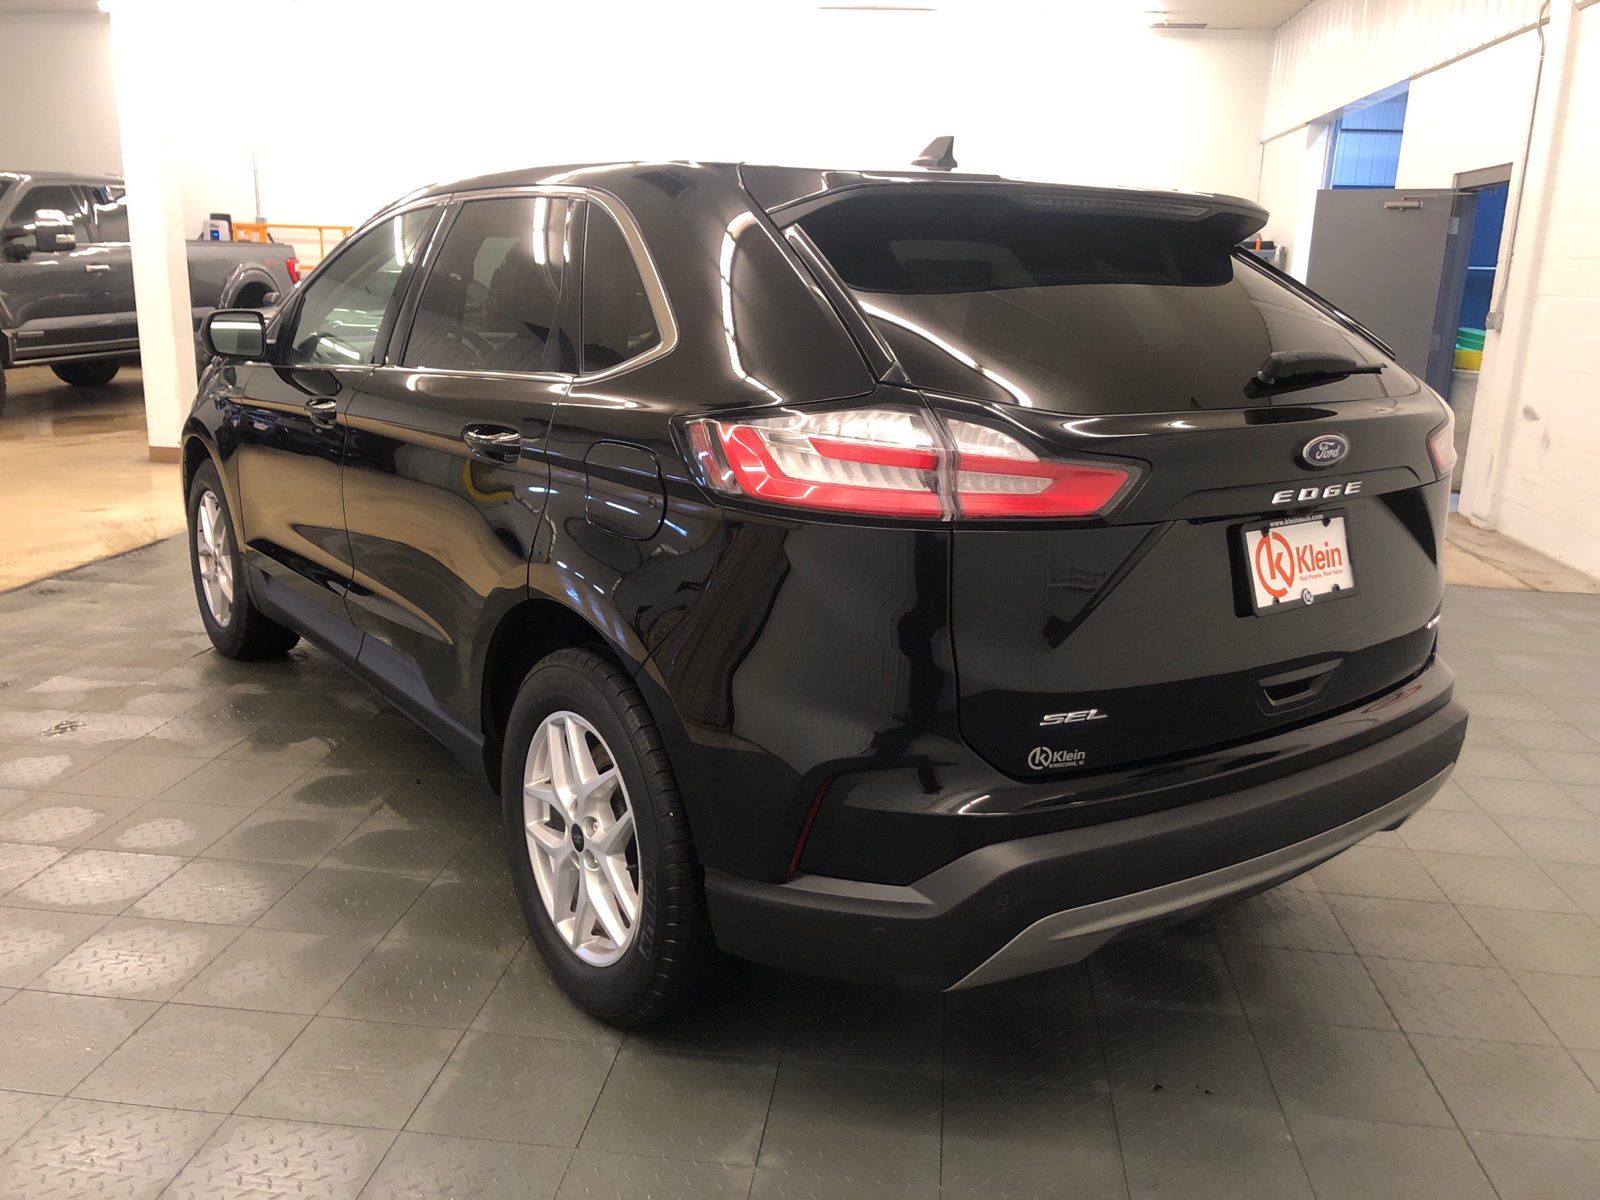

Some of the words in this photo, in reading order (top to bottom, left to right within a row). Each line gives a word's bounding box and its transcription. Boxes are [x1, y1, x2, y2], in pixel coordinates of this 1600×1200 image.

[1315, 441, 1341, 460] Ford
[1271, 481, 1362, 505] EDGE
[1295, 541, 1343, 574] Klein
[1039, 708, 1108, 726] SEL
[1052, 749, 1086, 762] Klein
